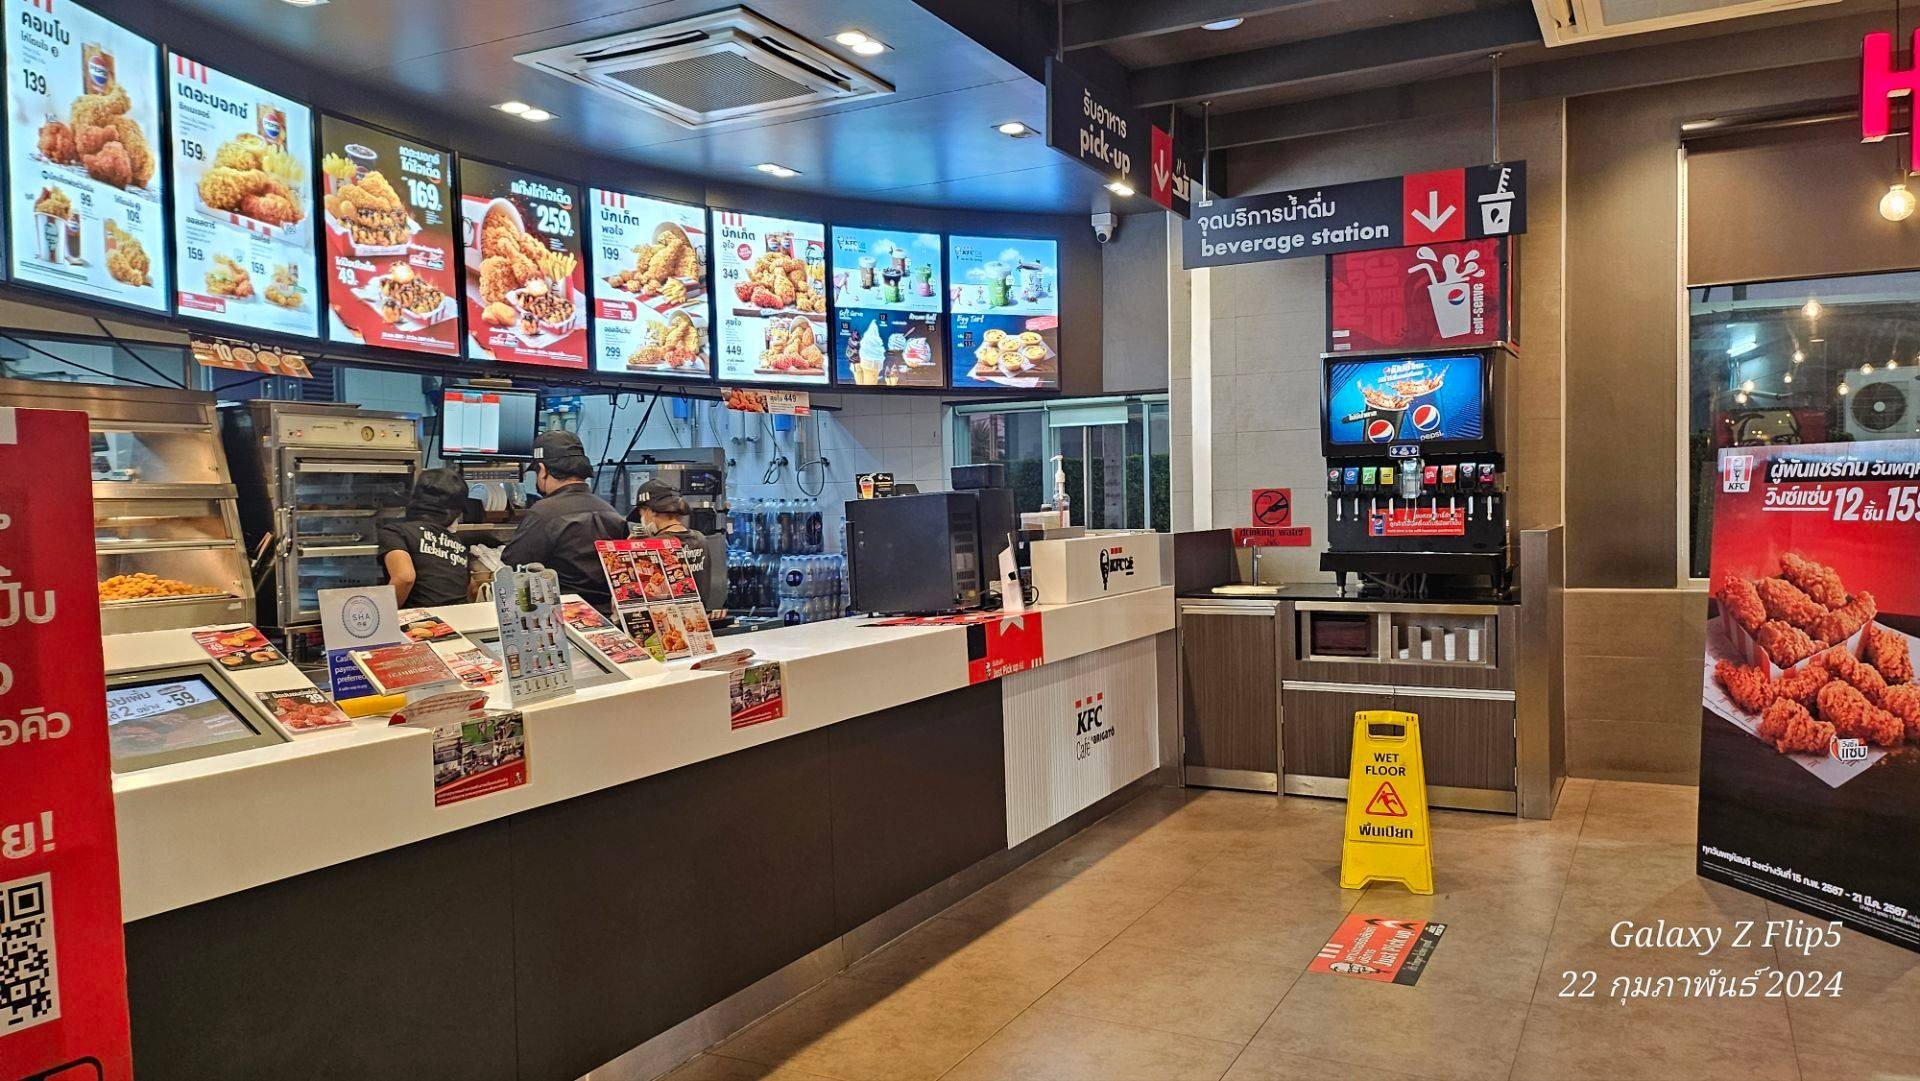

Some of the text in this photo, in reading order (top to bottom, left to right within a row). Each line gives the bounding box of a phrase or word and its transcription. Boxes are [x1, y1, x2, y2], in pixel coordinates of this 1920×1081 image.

[22, 11, 70, 45] คอมโบ
[1083, 88, 1127, 139] รับอาหาร
[1080, 124, 1131, 180] pick-up
[601, 208, 640, 226] บักเก็ต
[1197, 192, 1336, 237] จุดบริการน้ำดื่ม
[602, 225, 624, 236] พอใจ
[1201, 222, 1389, 258] beverage station
[1473, 283, 1484, 335] self-serve
[1420, 430, 1444, 441] pepsi
[1728, 482, 1746, 490] KFC
[1765, 485, 1833, 506] วิงซ์แซ่บ
[1833, 487, 1864, 521] 12
[1862, 500, 1884, 521] ชิ้น
[352, 613, 370, 621] SHA
[118, 706, 134, 717] 2
[1076, 705, 1102, 736] KFC
[1374, 752, 1399, 763] WET
[1365, 765, 1406, 777] FLOOR
[1359, 822, 1413, 839] พื้นเปียก
[1792, 872, 1802, 883] 15
[1821, 881, 1843, 897] 2567
[1851, 892, 1862, 904] 21
[1883, 902, 1907, 918] 2567
